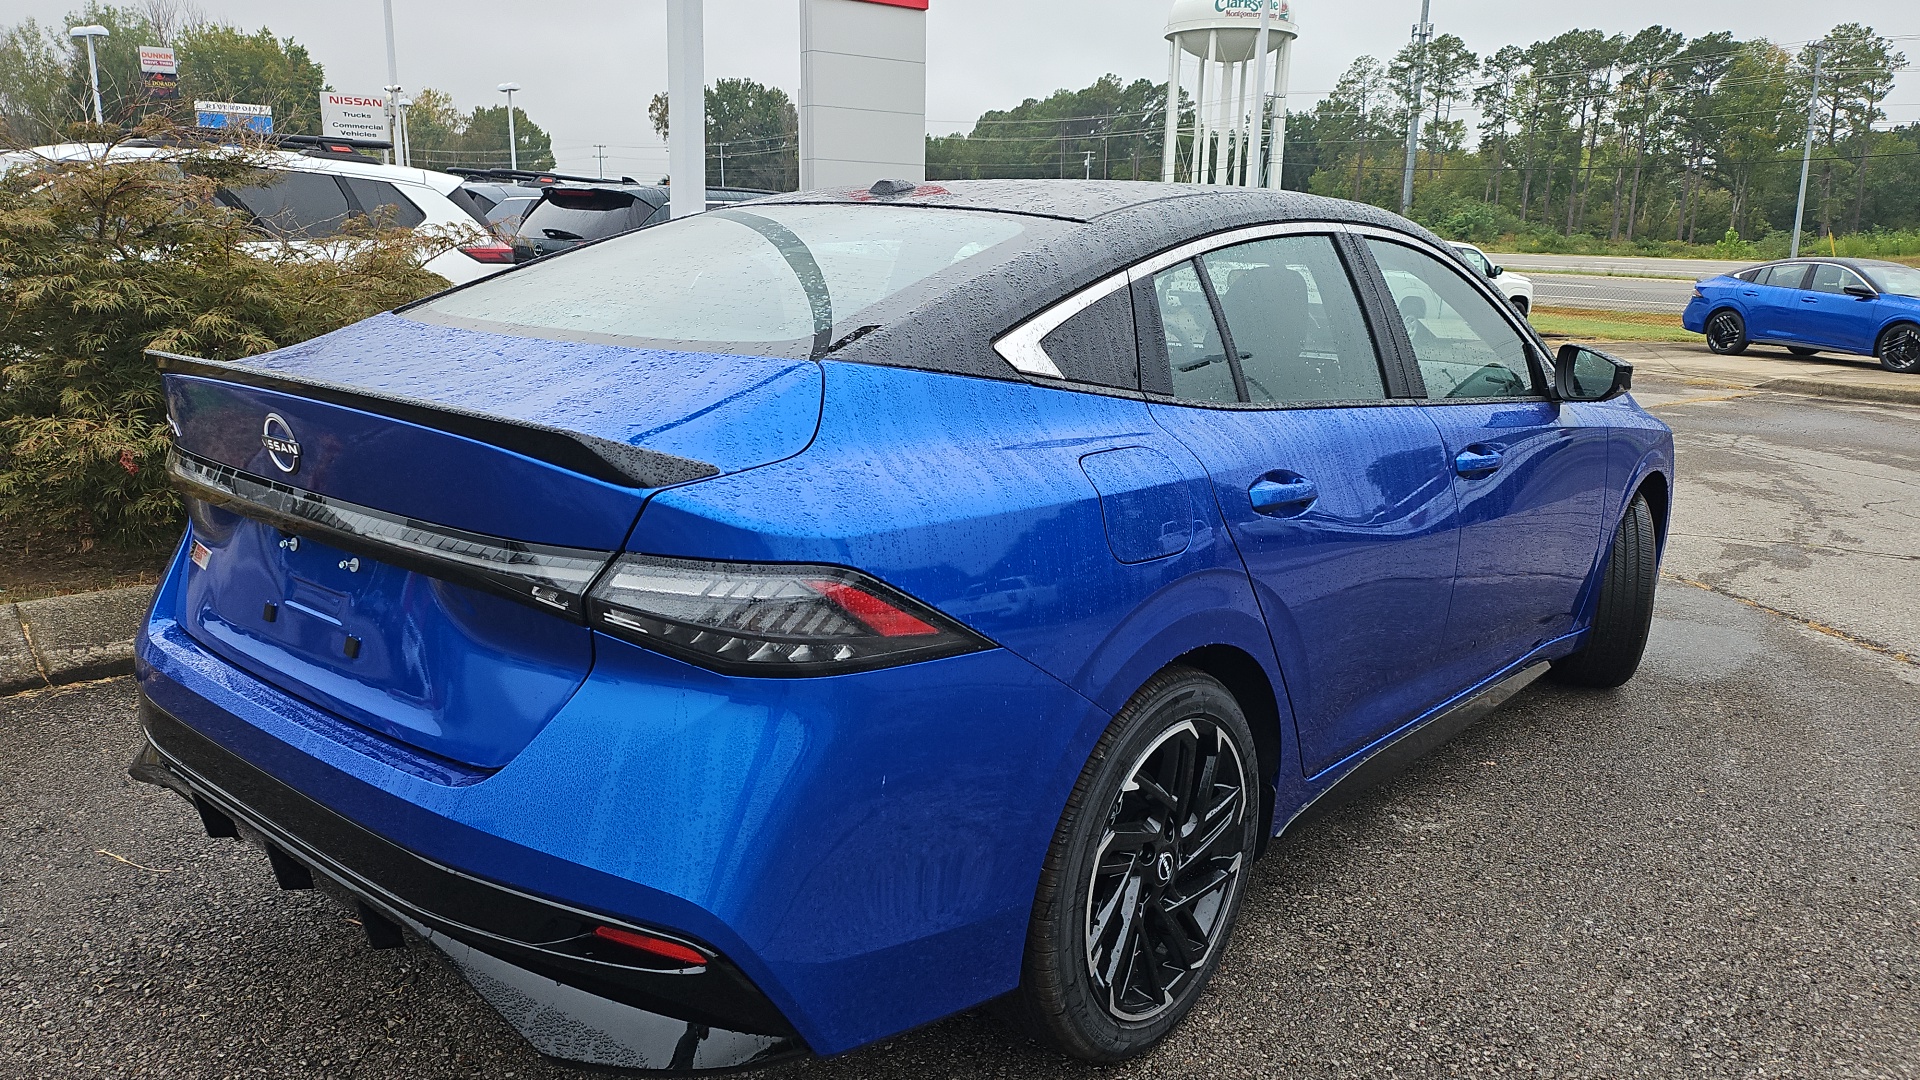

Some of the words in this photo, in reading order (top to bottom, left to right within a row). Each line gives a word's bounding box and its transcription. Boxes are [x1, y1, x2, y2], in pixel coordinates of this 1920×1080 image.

[1215, 0, 1278, 12] Clarksvle
[1225, 9, 1261, 19] Montgomery
[152, 80, 176, 88] DORADO
[329, 95, 382, 107] NISSAN
[343, 111, 371, 119] Trucks
[332, 121, 384, 131] Commercial
[340, 130, 377, 138] Vehicles
